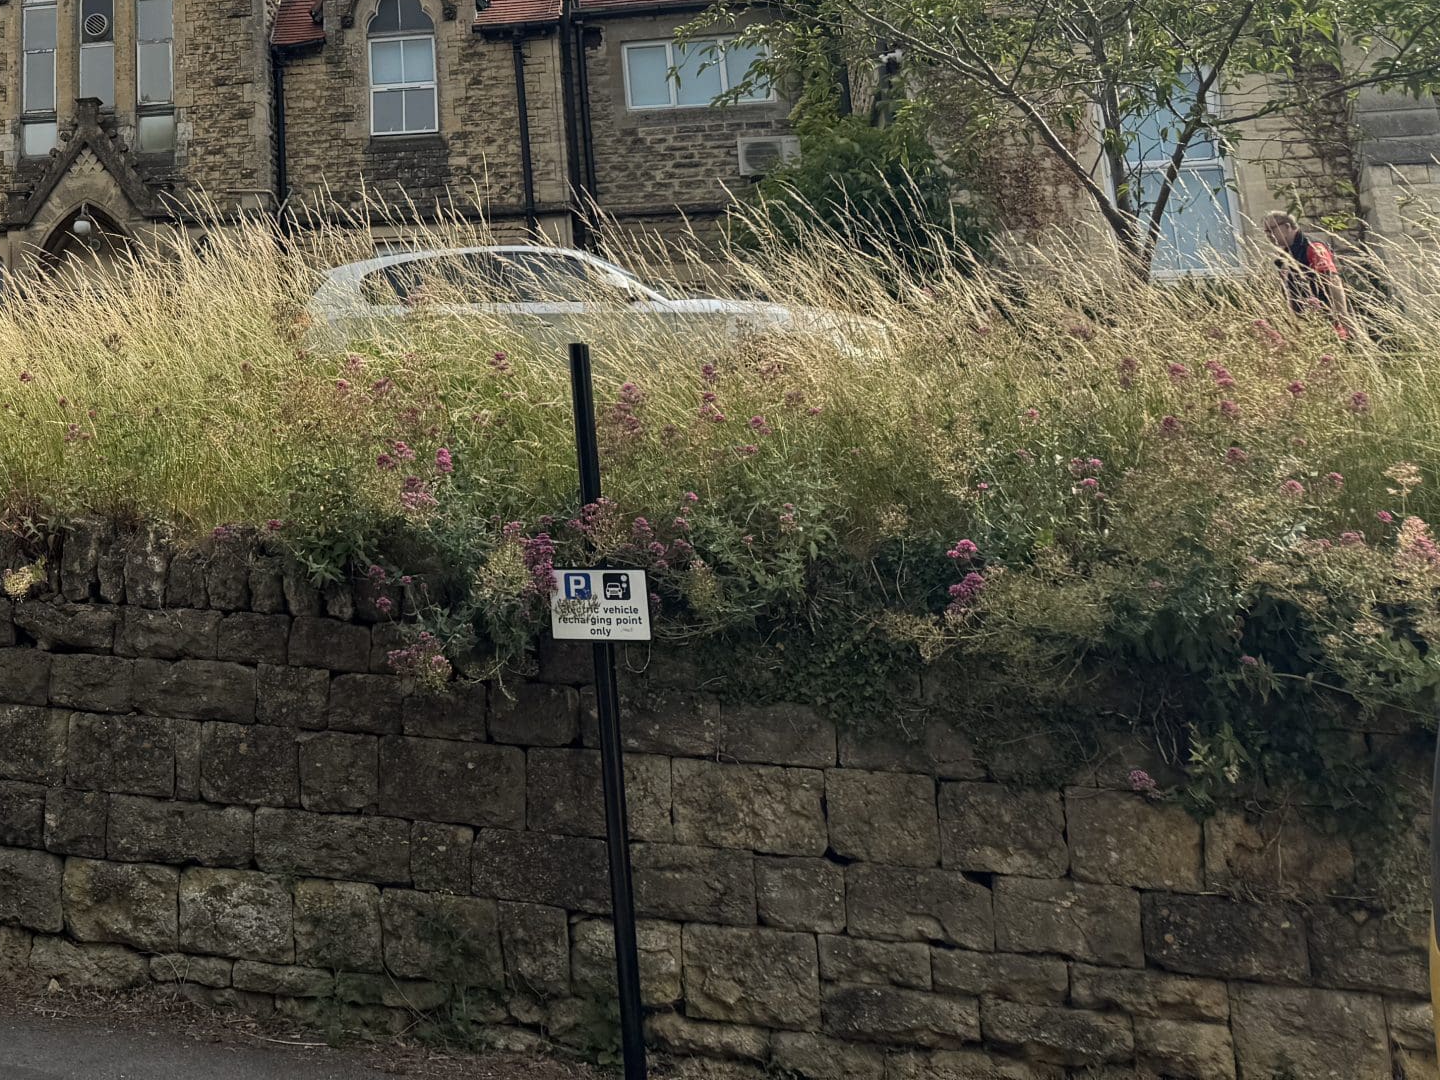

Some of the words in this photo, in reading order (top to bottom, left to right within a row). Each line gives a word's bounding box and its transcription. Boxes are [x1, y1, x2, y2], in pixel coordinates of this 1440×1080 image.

[569, 575, 586, 598] P
[603, 605, 639, 615] vehicle
[616, 616, 643, 626] point
[590, 626, 612, 637] only
